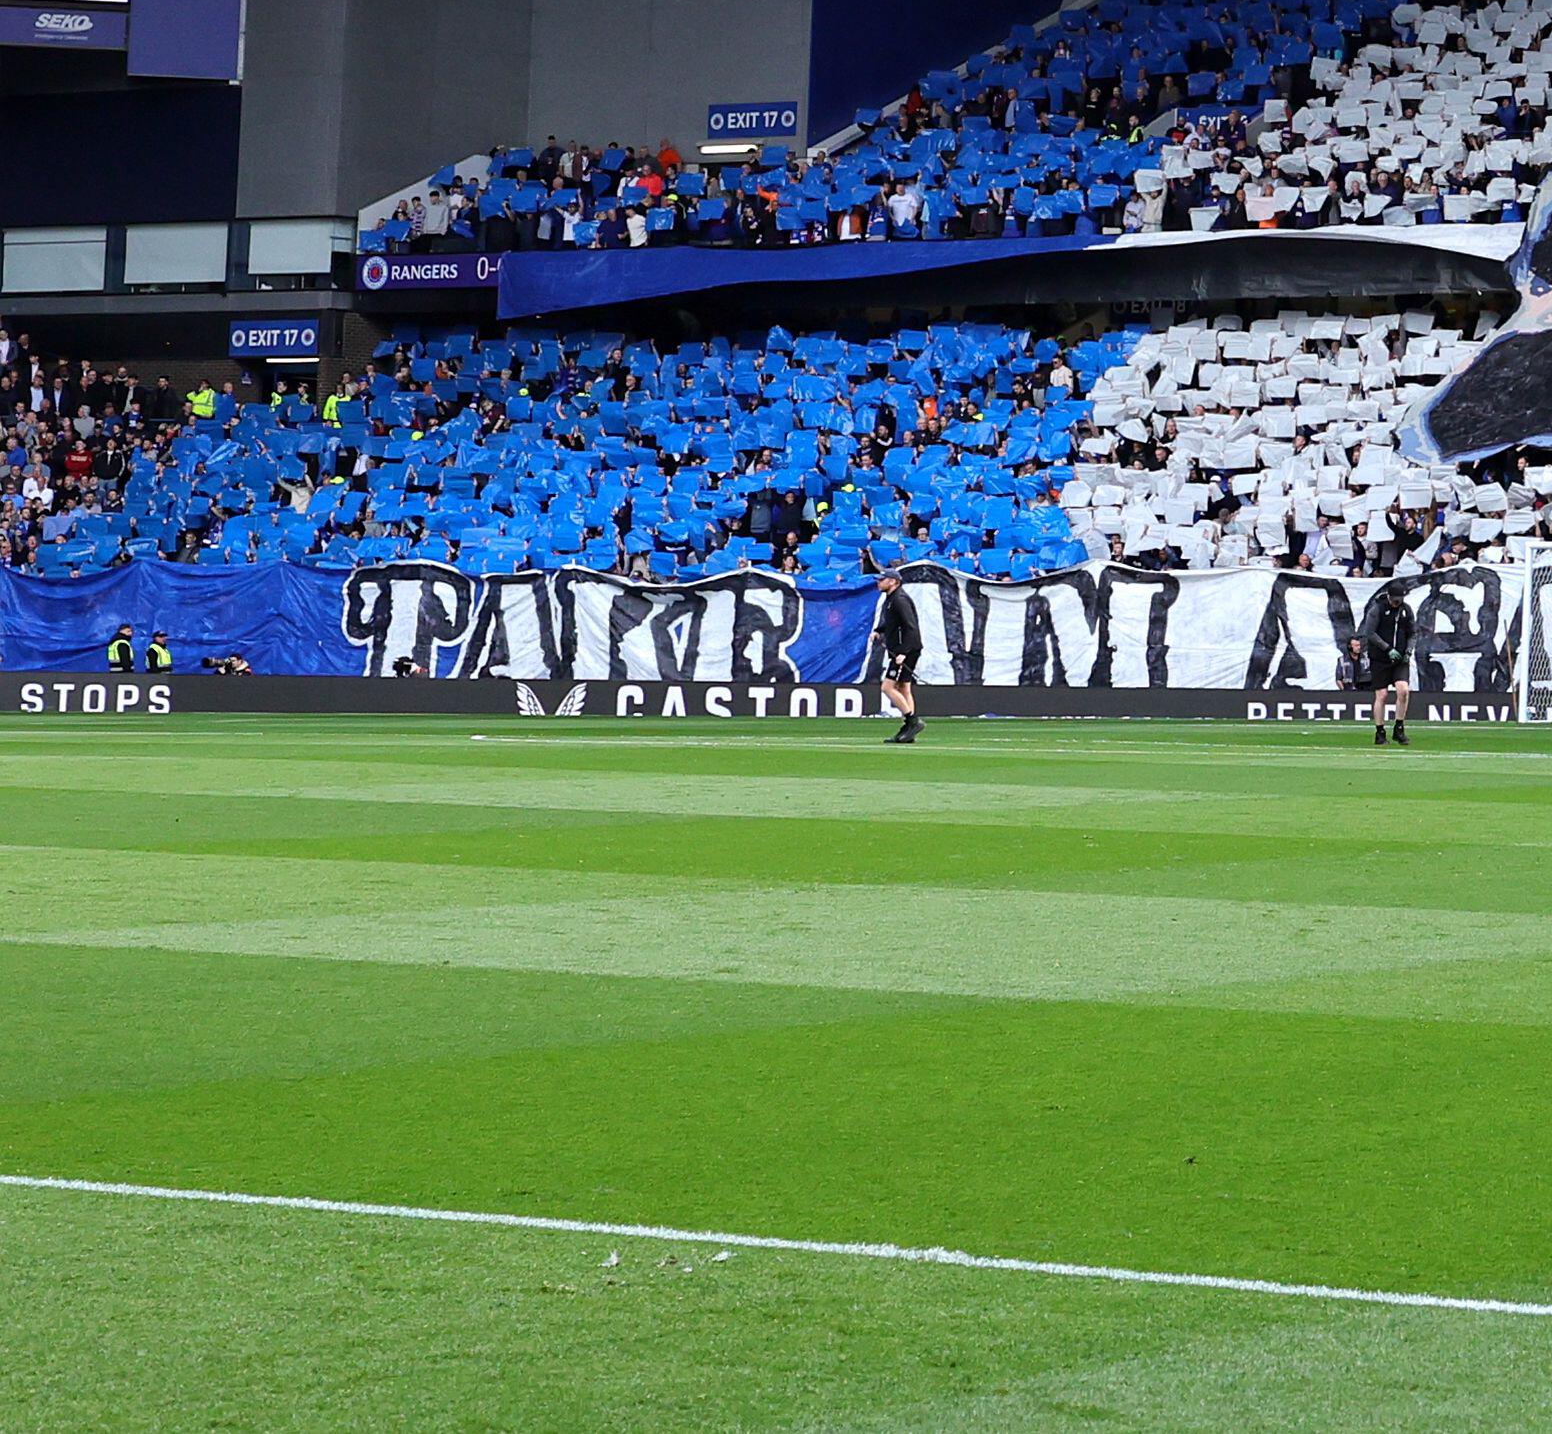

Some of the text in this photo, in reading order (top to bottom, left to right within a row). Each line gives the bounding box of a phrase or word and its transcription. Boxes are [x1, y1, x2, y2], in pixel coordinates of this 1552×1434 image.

[35, 13, 93, 32] SEKO
[727, 111, 778, 129] EXIT 17
[391, 264, 458, 280] RANGERS
[248, 329, 299, 346] EXIT 17
[20, 683, 172, 714] STOPS
